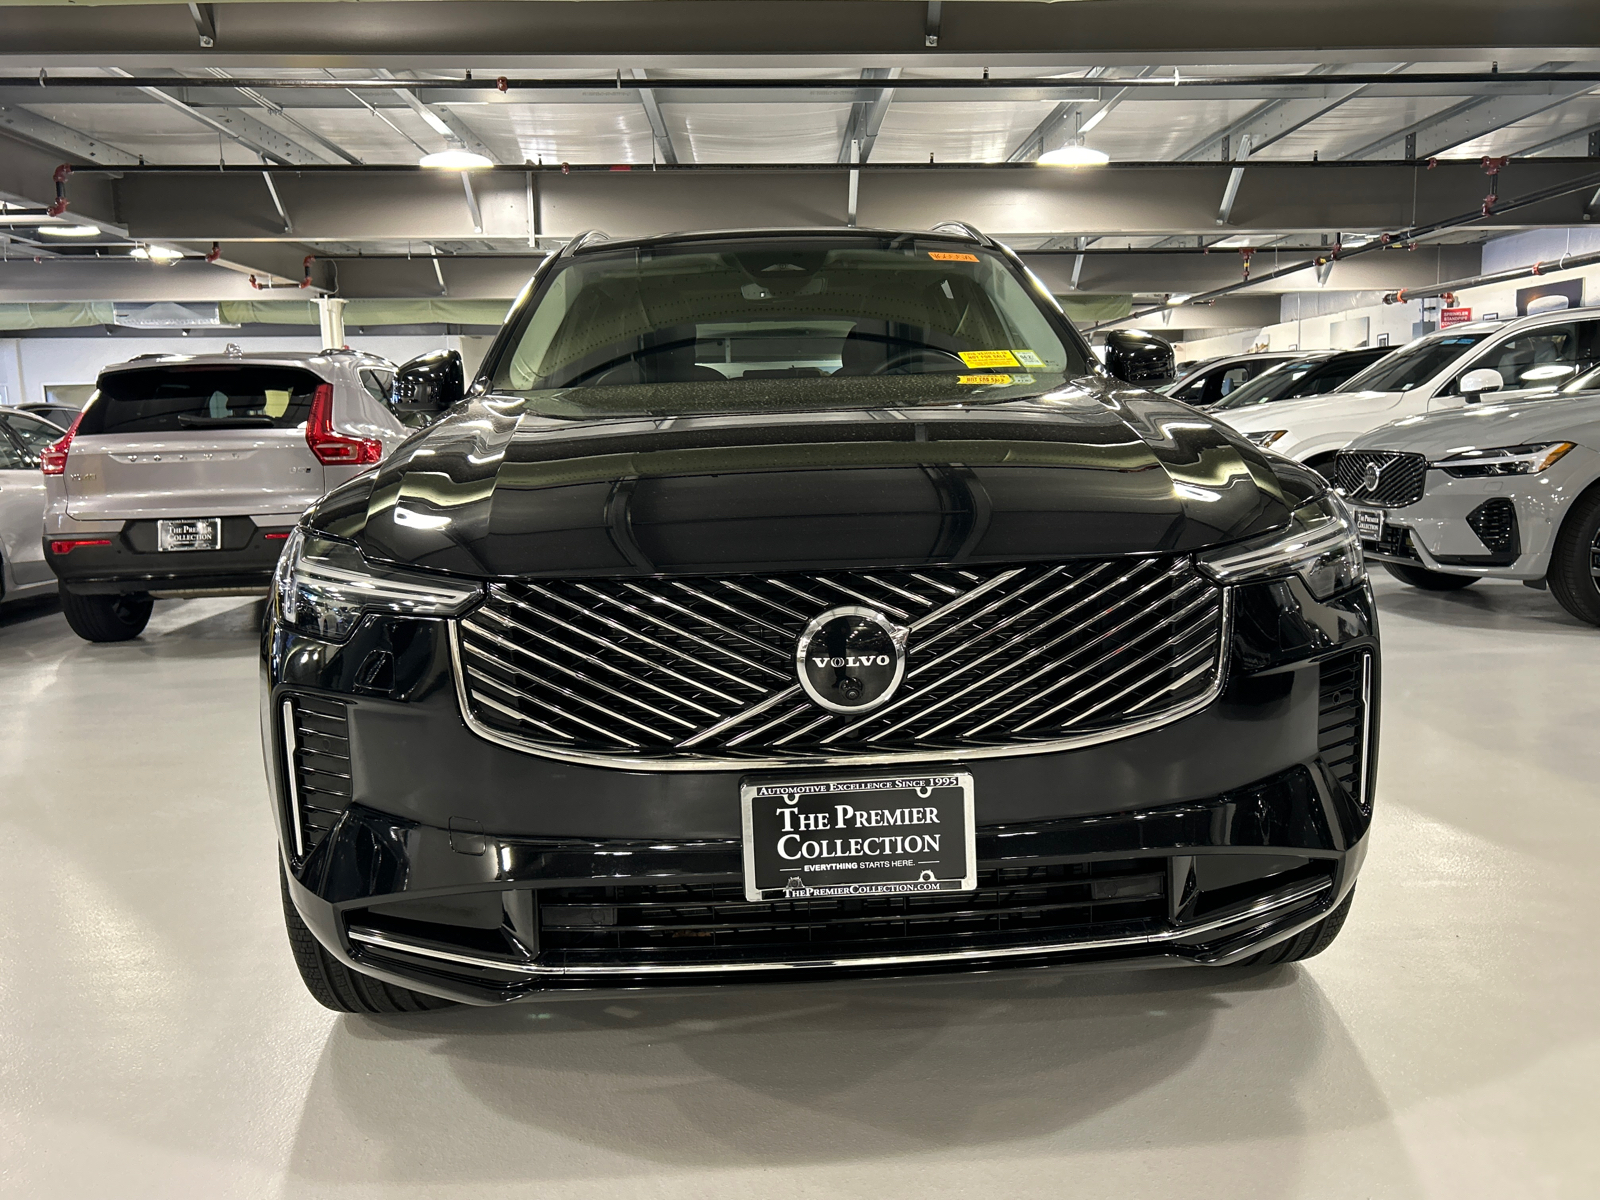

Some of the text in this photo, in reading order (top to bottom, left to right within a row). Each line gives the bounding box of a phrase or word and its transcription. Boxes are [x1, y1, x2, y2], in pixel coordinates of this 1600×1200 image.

[168, 526, 183, 534] THE
[167, 533, 213, 541] COLLECTION
[812, 655, 890, 668] VOLVO
[758, 777, 957, 796] AUTOMOTIVE EXCELLENCE SINCE 1995
[775, 804, 940, 832] THE PREMIER
[776, 834, 941, 860] COLLECTION
[804, 859, 916, 872] EVERYTHING STARTS HERE.
